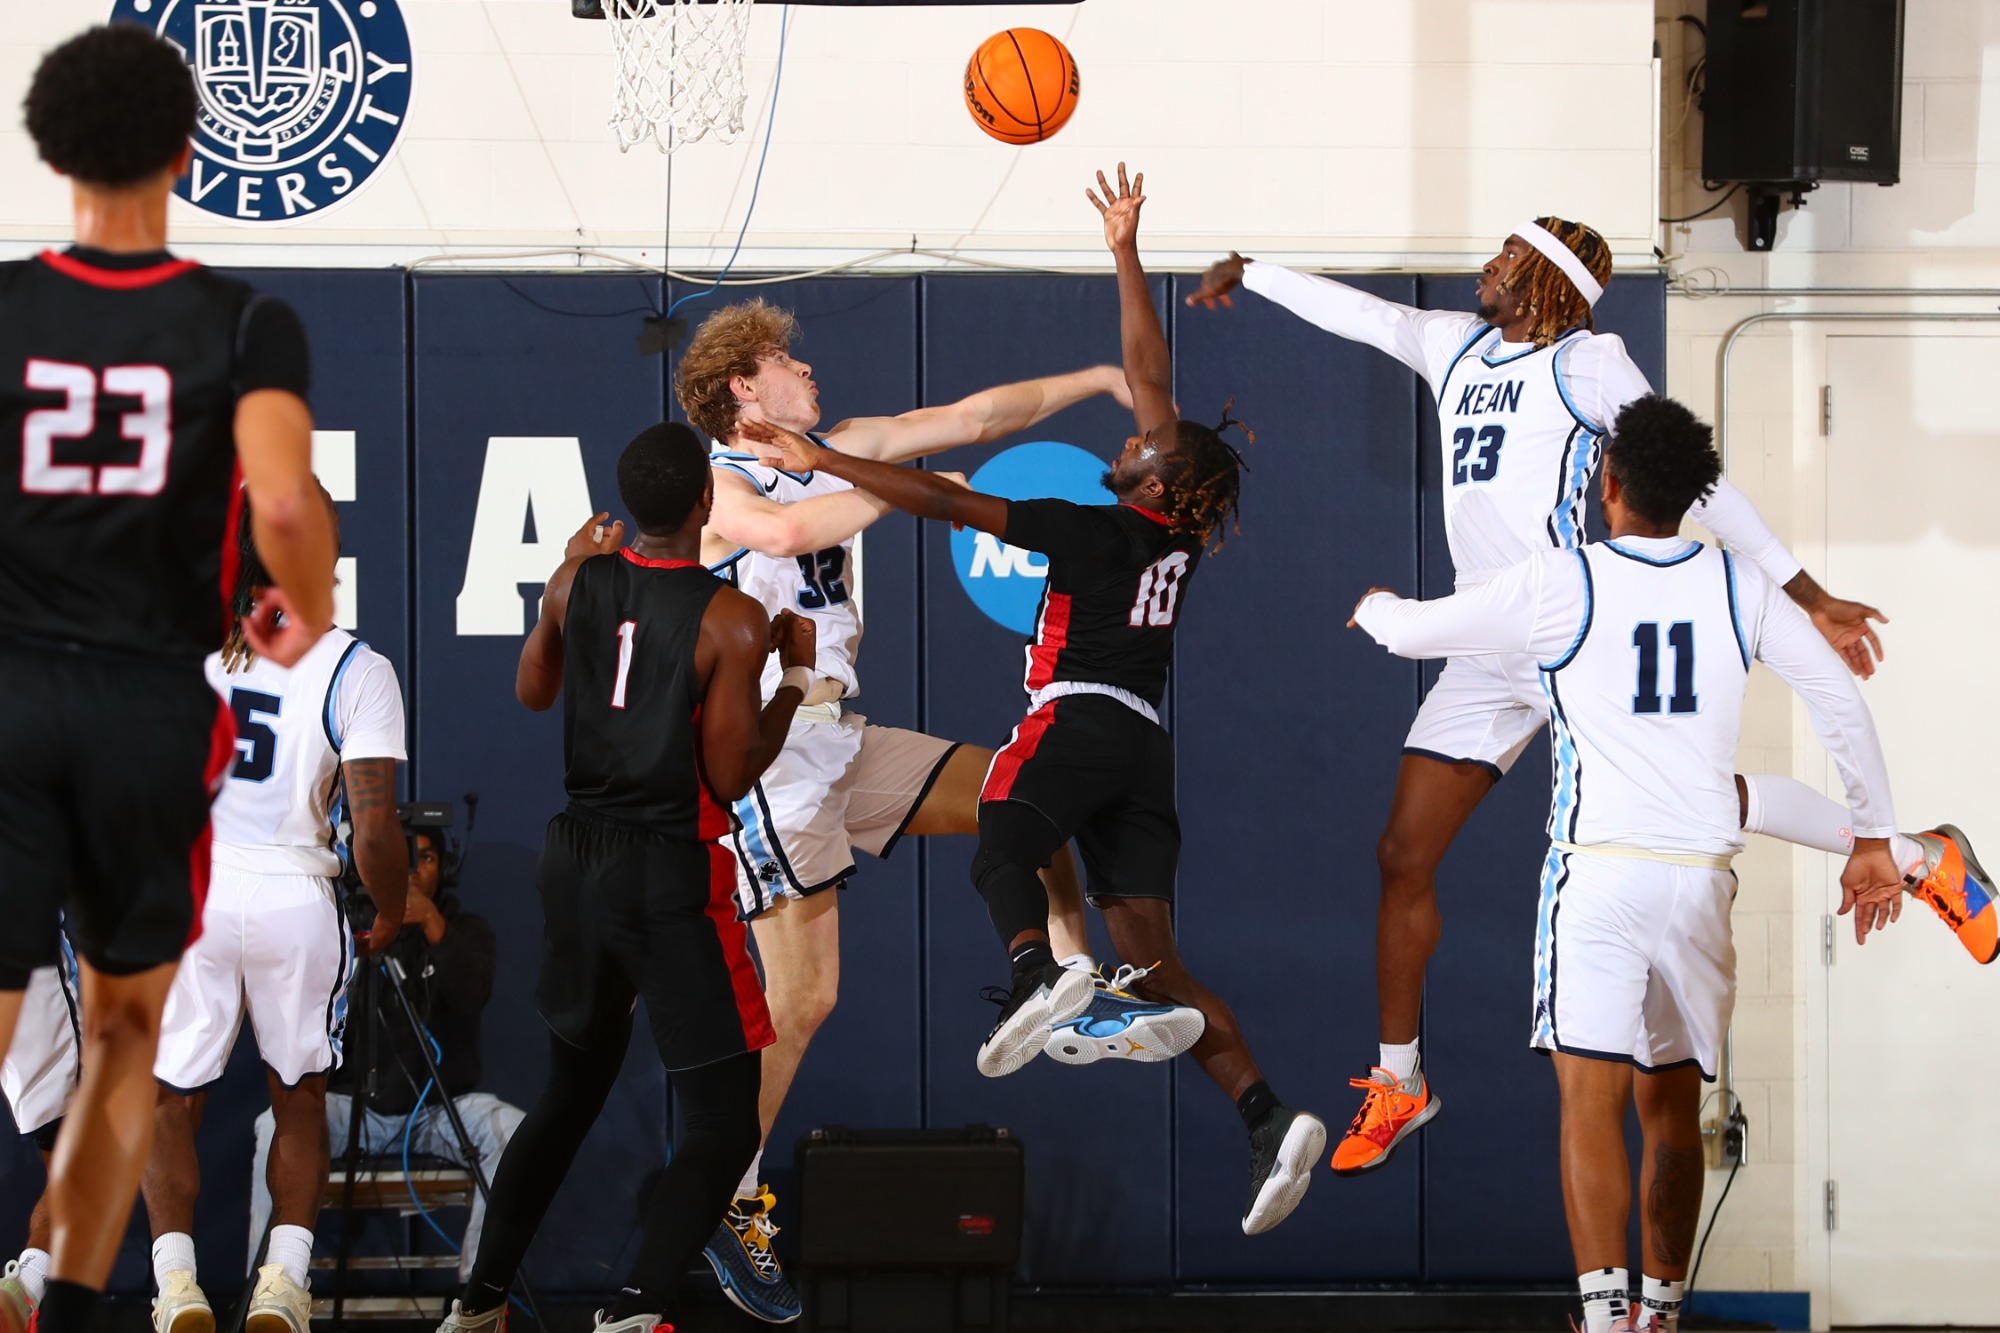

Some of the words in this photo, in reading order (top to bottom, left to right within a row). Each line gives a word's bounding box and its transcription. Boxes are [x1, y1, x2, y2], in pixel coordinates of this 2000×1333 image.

[190, 51, 408, 218] VERSITY
[280, 77, 335, 142] DISCENS
[22, 358, 173, 497] 23
[1456, 379, 1525, 416] KEAN
[1452, 424, 1508, 486] 23
[796, 544, 849, 611] 32
[969, 531, 1050, 578] NC
[1128, 550, 1190, 628] 10
[611, 620, 638, 710] 1
[1631, 620, 1699, 716] 11
[229, 685, 283, 784] 5
